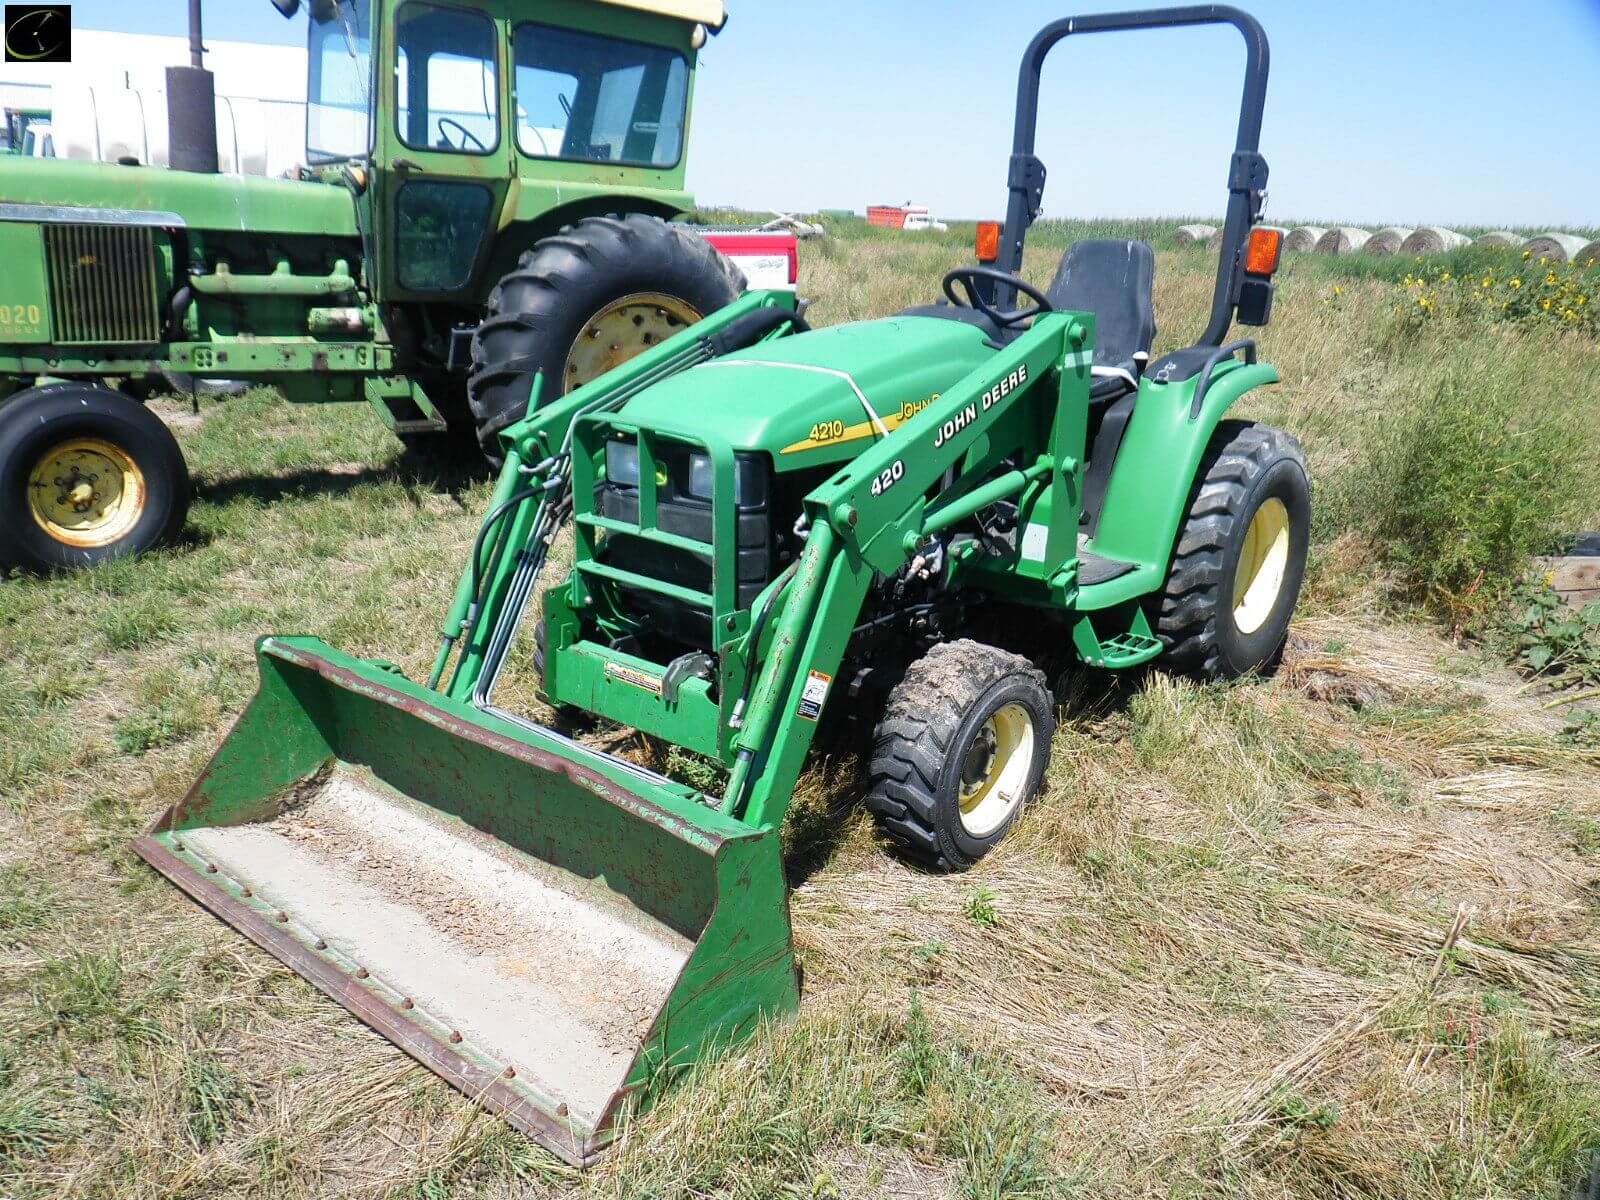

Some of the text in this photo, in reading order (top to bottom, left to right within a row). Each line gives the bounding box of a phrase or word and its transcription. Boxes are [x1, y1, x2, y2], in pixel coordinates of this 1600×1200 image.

[934, 364, 1027, 447] JOHN DEERE
[809, 420, 844, 440] 4210
[870, 460, 904, 496] 420
